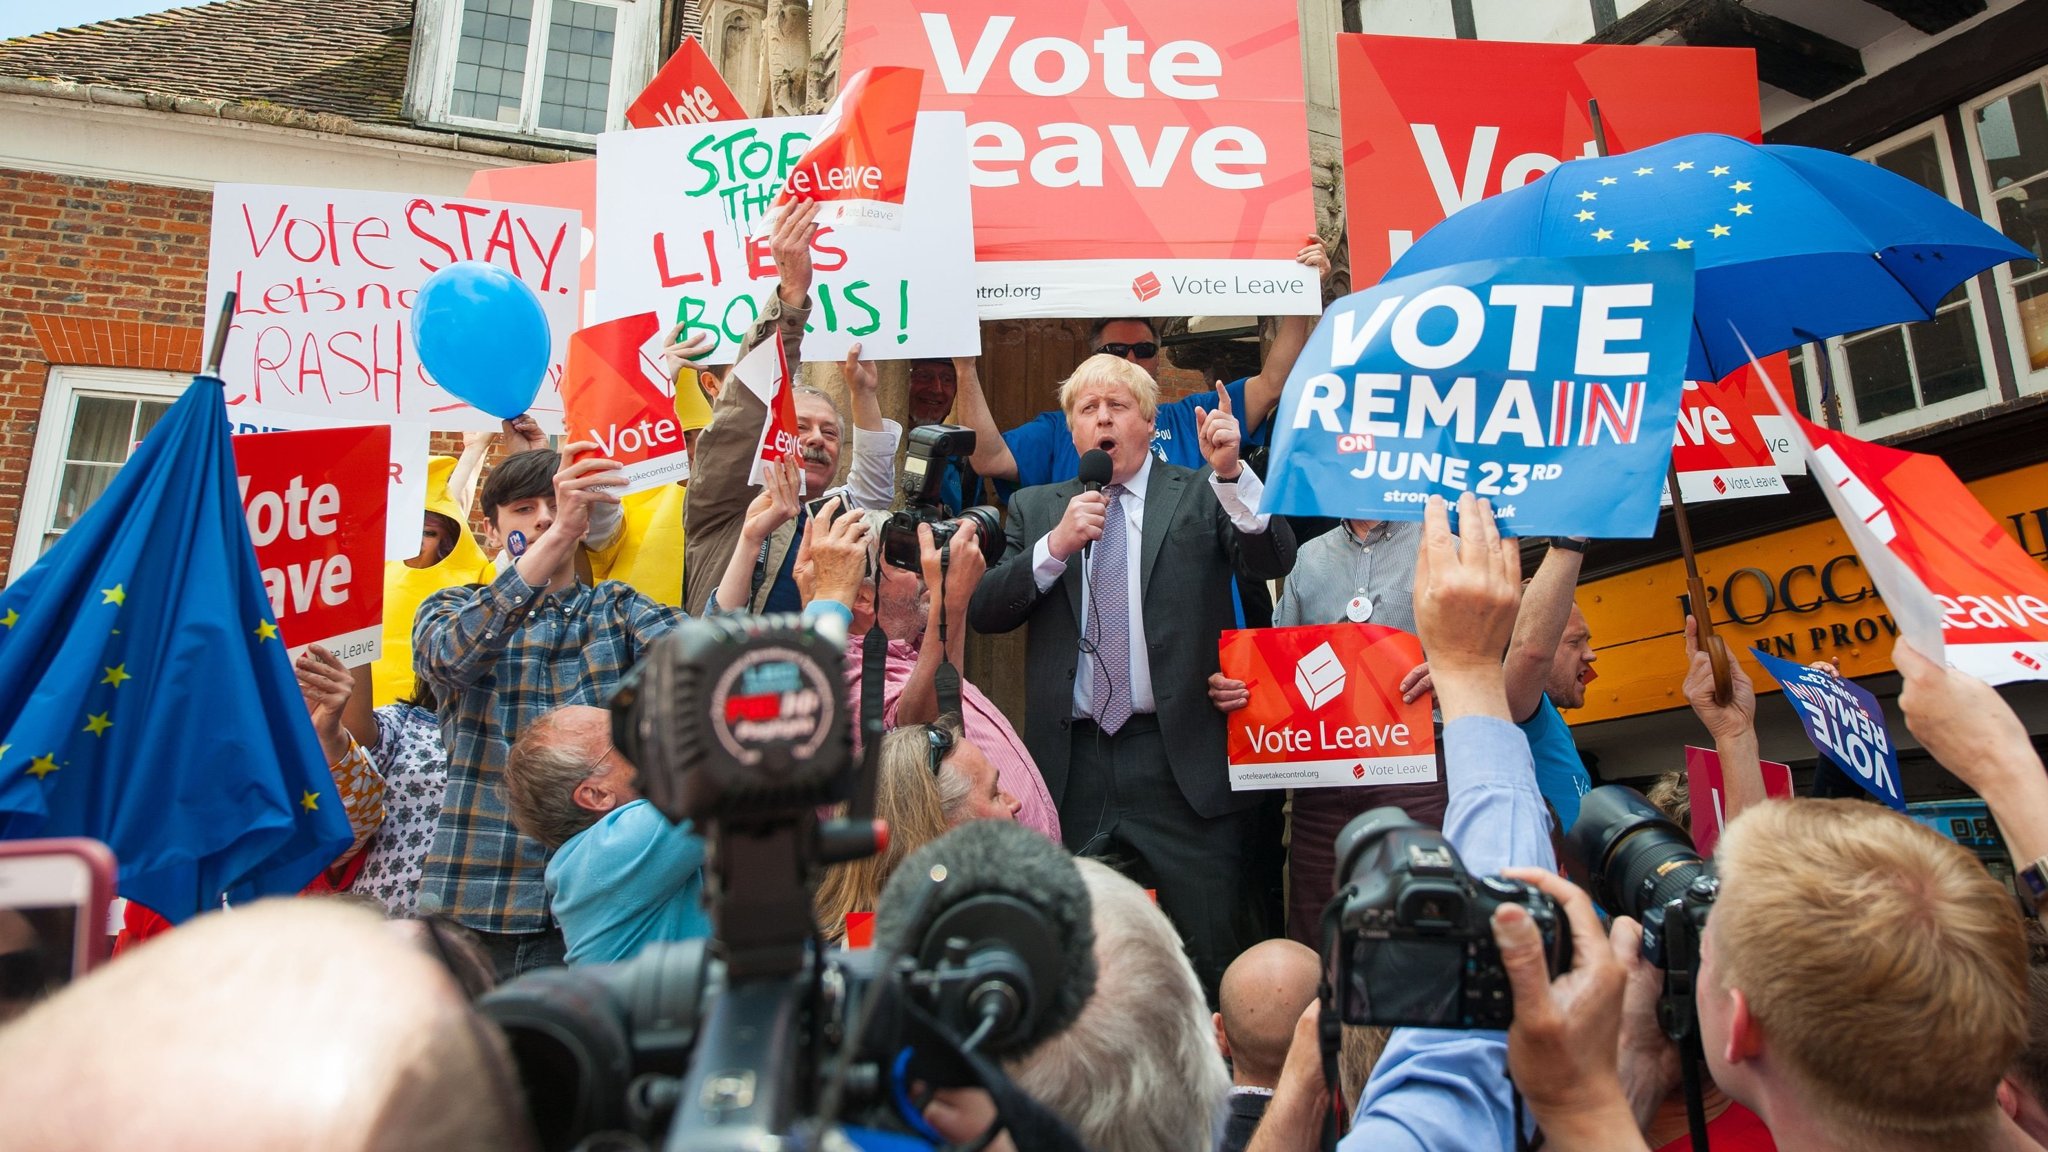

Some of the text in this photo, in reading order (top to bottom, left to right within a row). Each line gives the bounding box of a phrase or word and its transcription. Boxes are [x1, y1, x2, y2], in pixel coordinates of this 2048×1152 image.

[920, 12, 1222, 100] Vote
[685, 127, 811, 197] STOP
[813, 161, 883, 191] Leave
[968, 120, 1267, 190] eave
[862, 206, 894, 220] Leave
[242, 203, 396, 270] Vote
[405, 199, 569, 294] STAY.
[235, 270, 417, 314] Let's no
[976, 274, 1304, 300] trol.org Vote Leave
[675, 279, 908, 361] BOIS!
[1330, 283, 1653, 376] VOTE
[1292, 373, 1647, 448] REMAIN
[589, 418, 677, 458] Vote
[1339, 436, 1373, 453] ON
[1350, 451, 1562, 496] JUNE 23RD
[1727, 475, 1778, 490] Vote Leave
[261, 554, 351, 619] ave
[1934, 594, 2048, 629] eave
[343, 639, 374, 659] Leave
[1754, 614, 1897, 657] EN PROV
[1245, 720, 1409, 753] Vote Leave
[1785, 680, 1888, 755] REMAIN
[1801, 700, 1898, 799] VOTE
[1238, 763, 1428, 781] voteleavetakecontrol.org Vote Leave
